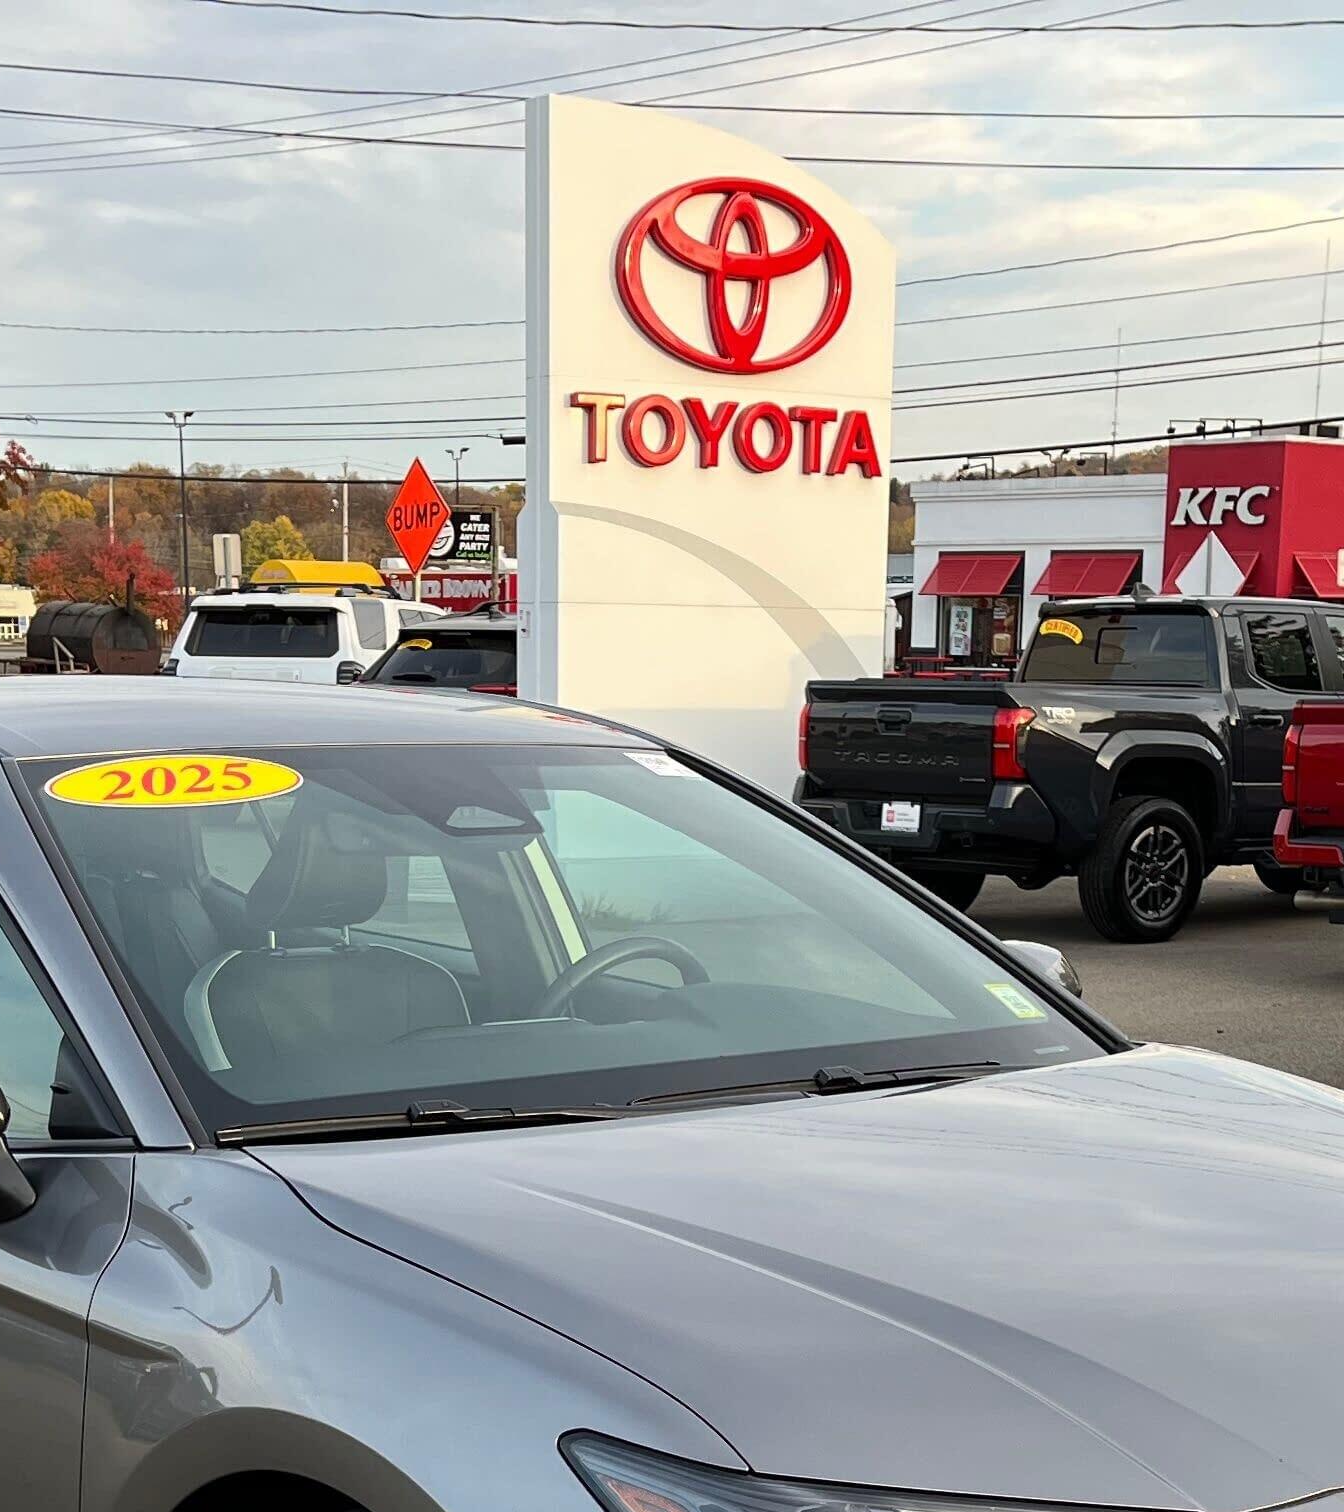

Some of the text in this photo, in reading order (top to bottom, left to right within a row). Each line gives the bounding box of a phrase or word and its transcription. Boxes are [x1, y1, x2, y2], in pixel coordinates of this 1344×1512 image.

[570, 391, 882, 479] TOYOTA
[392, 501, 441, 532] BUMP
[1170, 485, 1270, 526] KFC
[460, 522, 491, 533] CATER
[459, 542, 489, 551] PARTY
[833, 750, 960, 768] TACOMA
[100, 762, 253, 801] 2025
